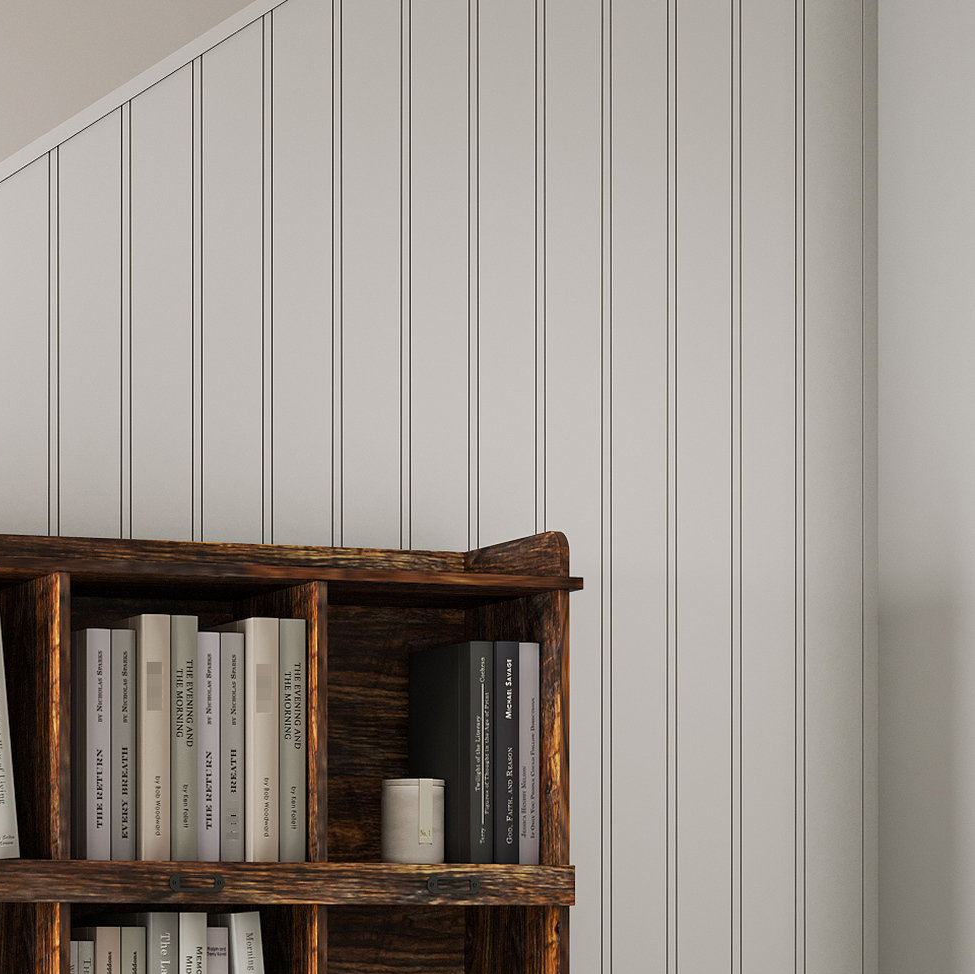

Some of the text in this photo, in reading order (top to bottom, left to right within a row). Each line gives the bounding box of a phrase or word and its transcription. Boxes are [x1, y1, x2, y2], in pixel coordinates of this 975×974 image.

[176, 668, 184, 738] THE MORNING
[284, 671, 292, 741] THE MORNING
[293, 662, 301, 750] THE EVENING AND
[160, 932, 171, 955] The
[245, 932, 256, 971] Morning
